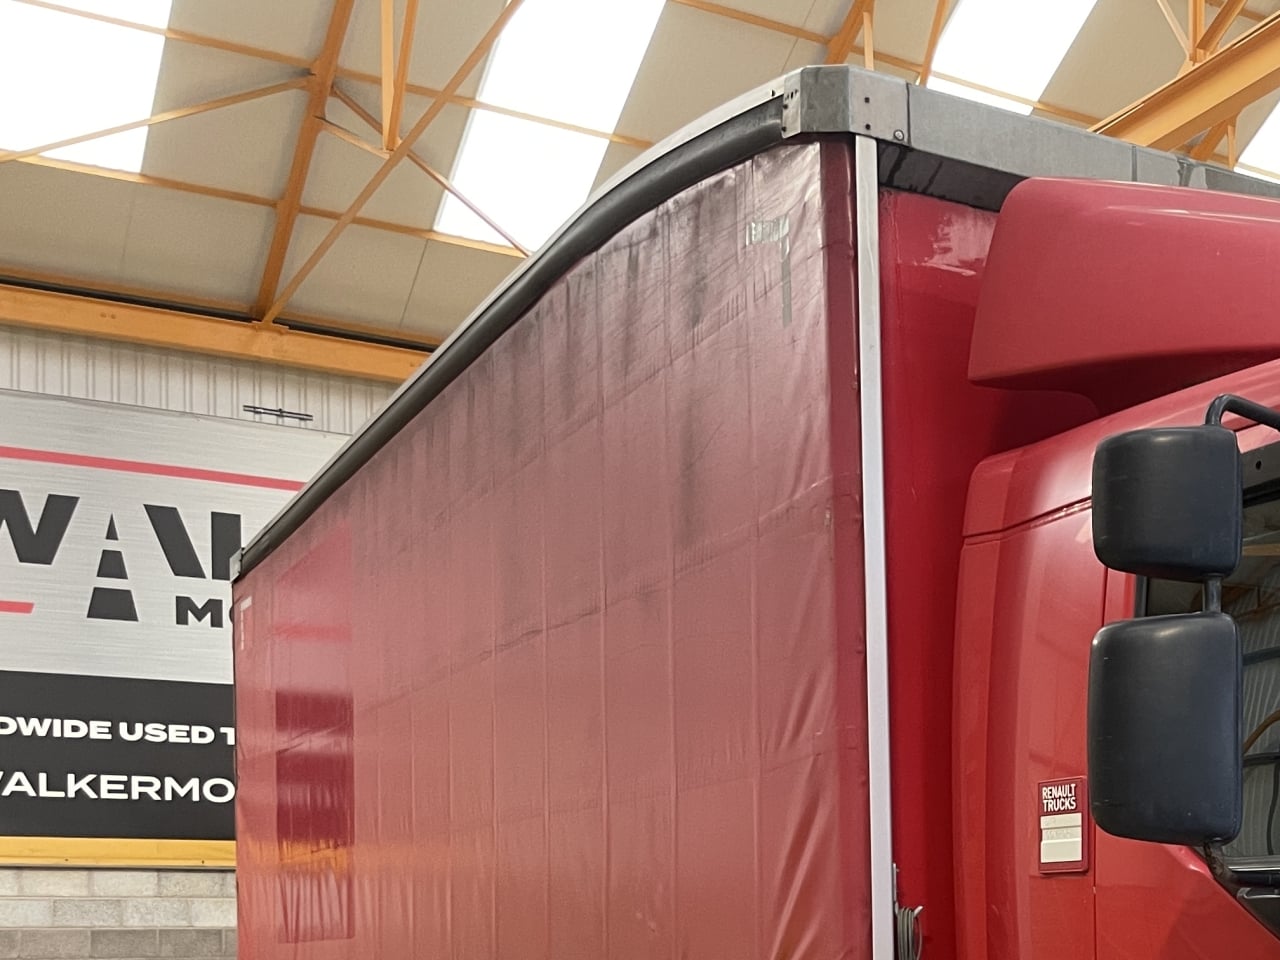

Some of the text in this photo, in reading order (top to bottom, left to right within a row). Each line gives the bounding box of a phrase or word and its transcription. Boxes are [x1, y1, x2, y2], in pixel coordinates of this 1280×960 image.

[118, 721, 216, 744] USED
[0, 770, 236, 804] ALKERMO
[1041, 783, 1077, 800] RENAULT
[1042, 796, 1078, 813] TRUCKS
